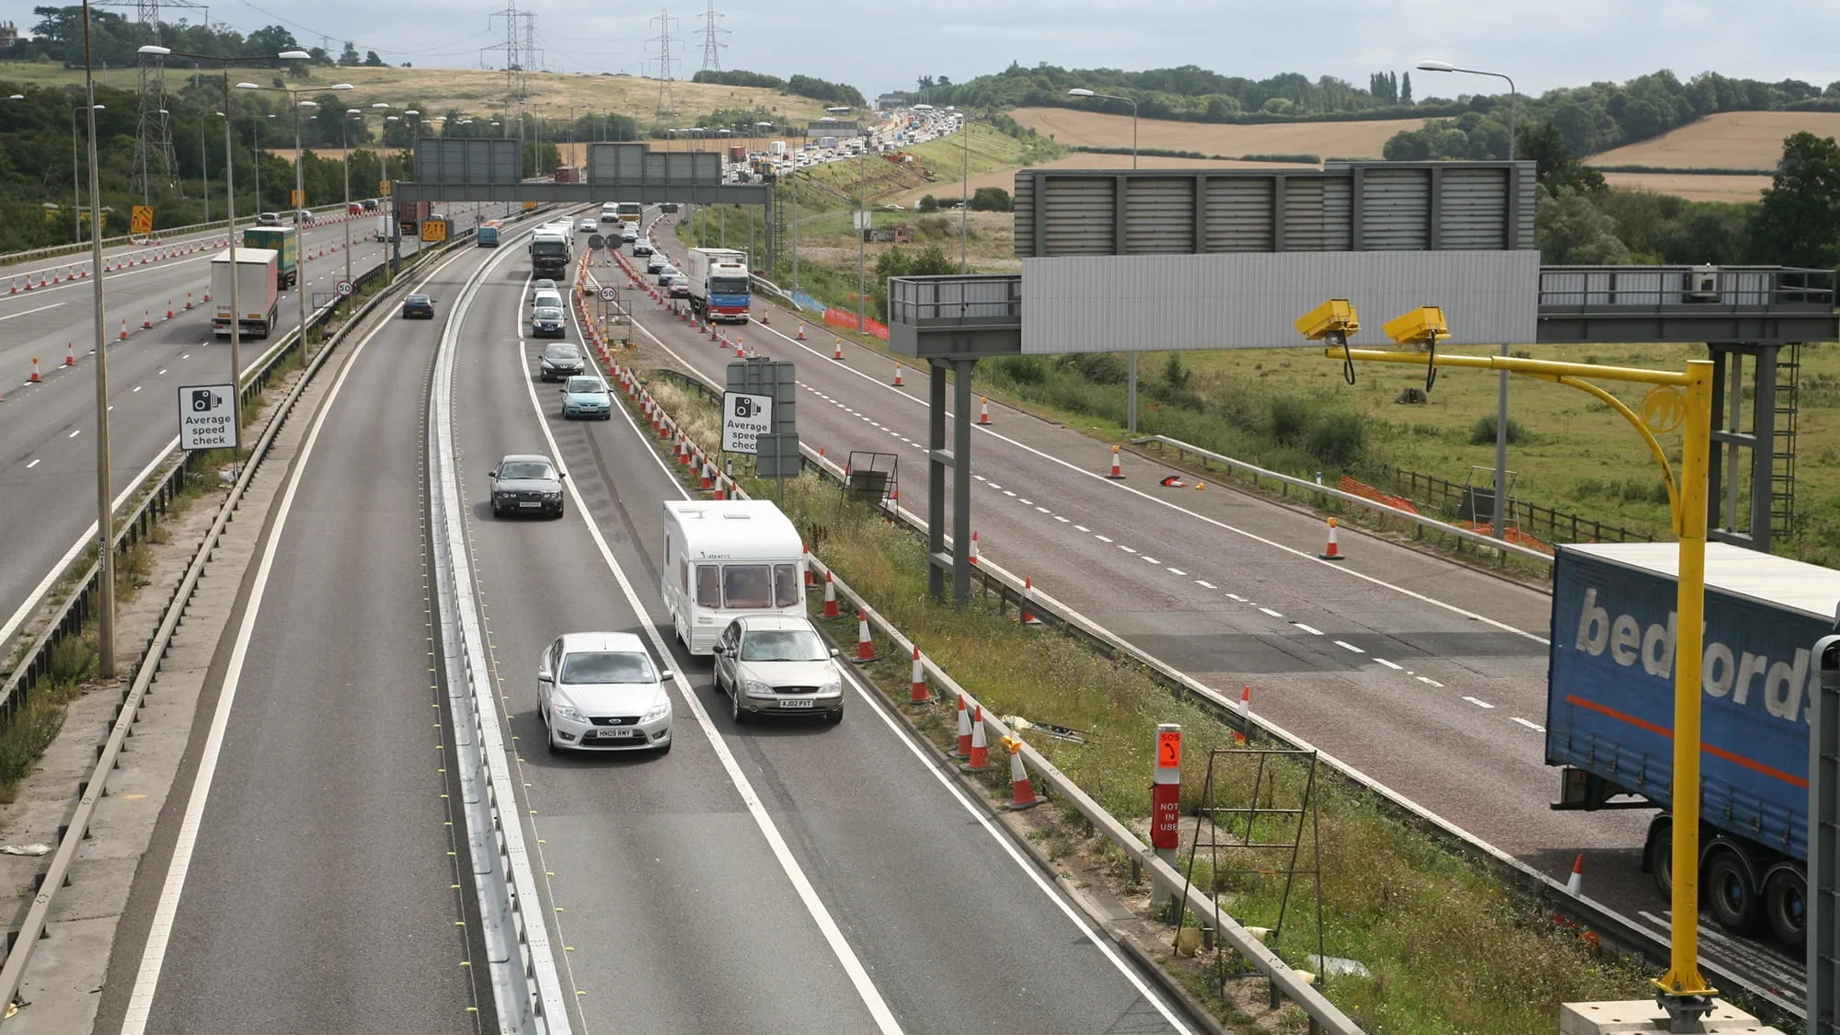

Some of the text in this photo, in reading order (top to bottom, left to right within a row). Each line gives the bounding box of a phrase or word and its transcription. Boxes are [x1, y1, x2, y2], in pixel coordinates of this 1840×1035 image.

[185, 416, 231, 425] Average
[192, 425, 225, 435] speed
[727, 420, 767, 432] Average
[192, 436, 226, 445] check
[1575, 588, 1811, 726] bedord
[599, 729, 617, 737] HN09
